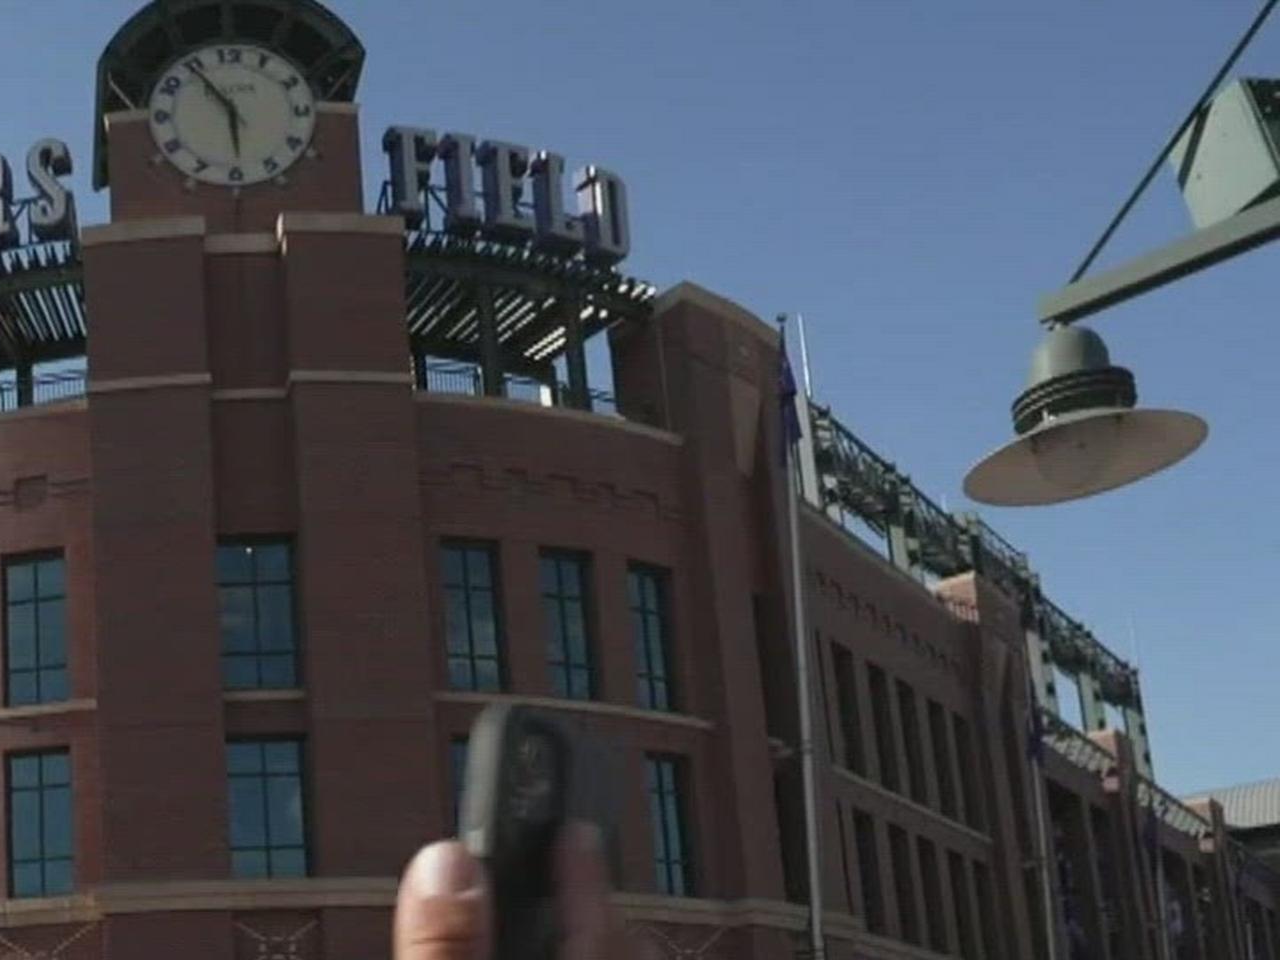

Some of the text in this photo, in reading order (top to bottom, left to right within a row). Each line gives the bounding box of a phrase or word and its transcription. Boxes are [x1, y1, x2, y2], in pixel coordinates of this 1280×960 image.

[218, 49, 242, 64] 12
[159, 76, 181, 96] 10
[382, 125, 631, 265] FIELD
